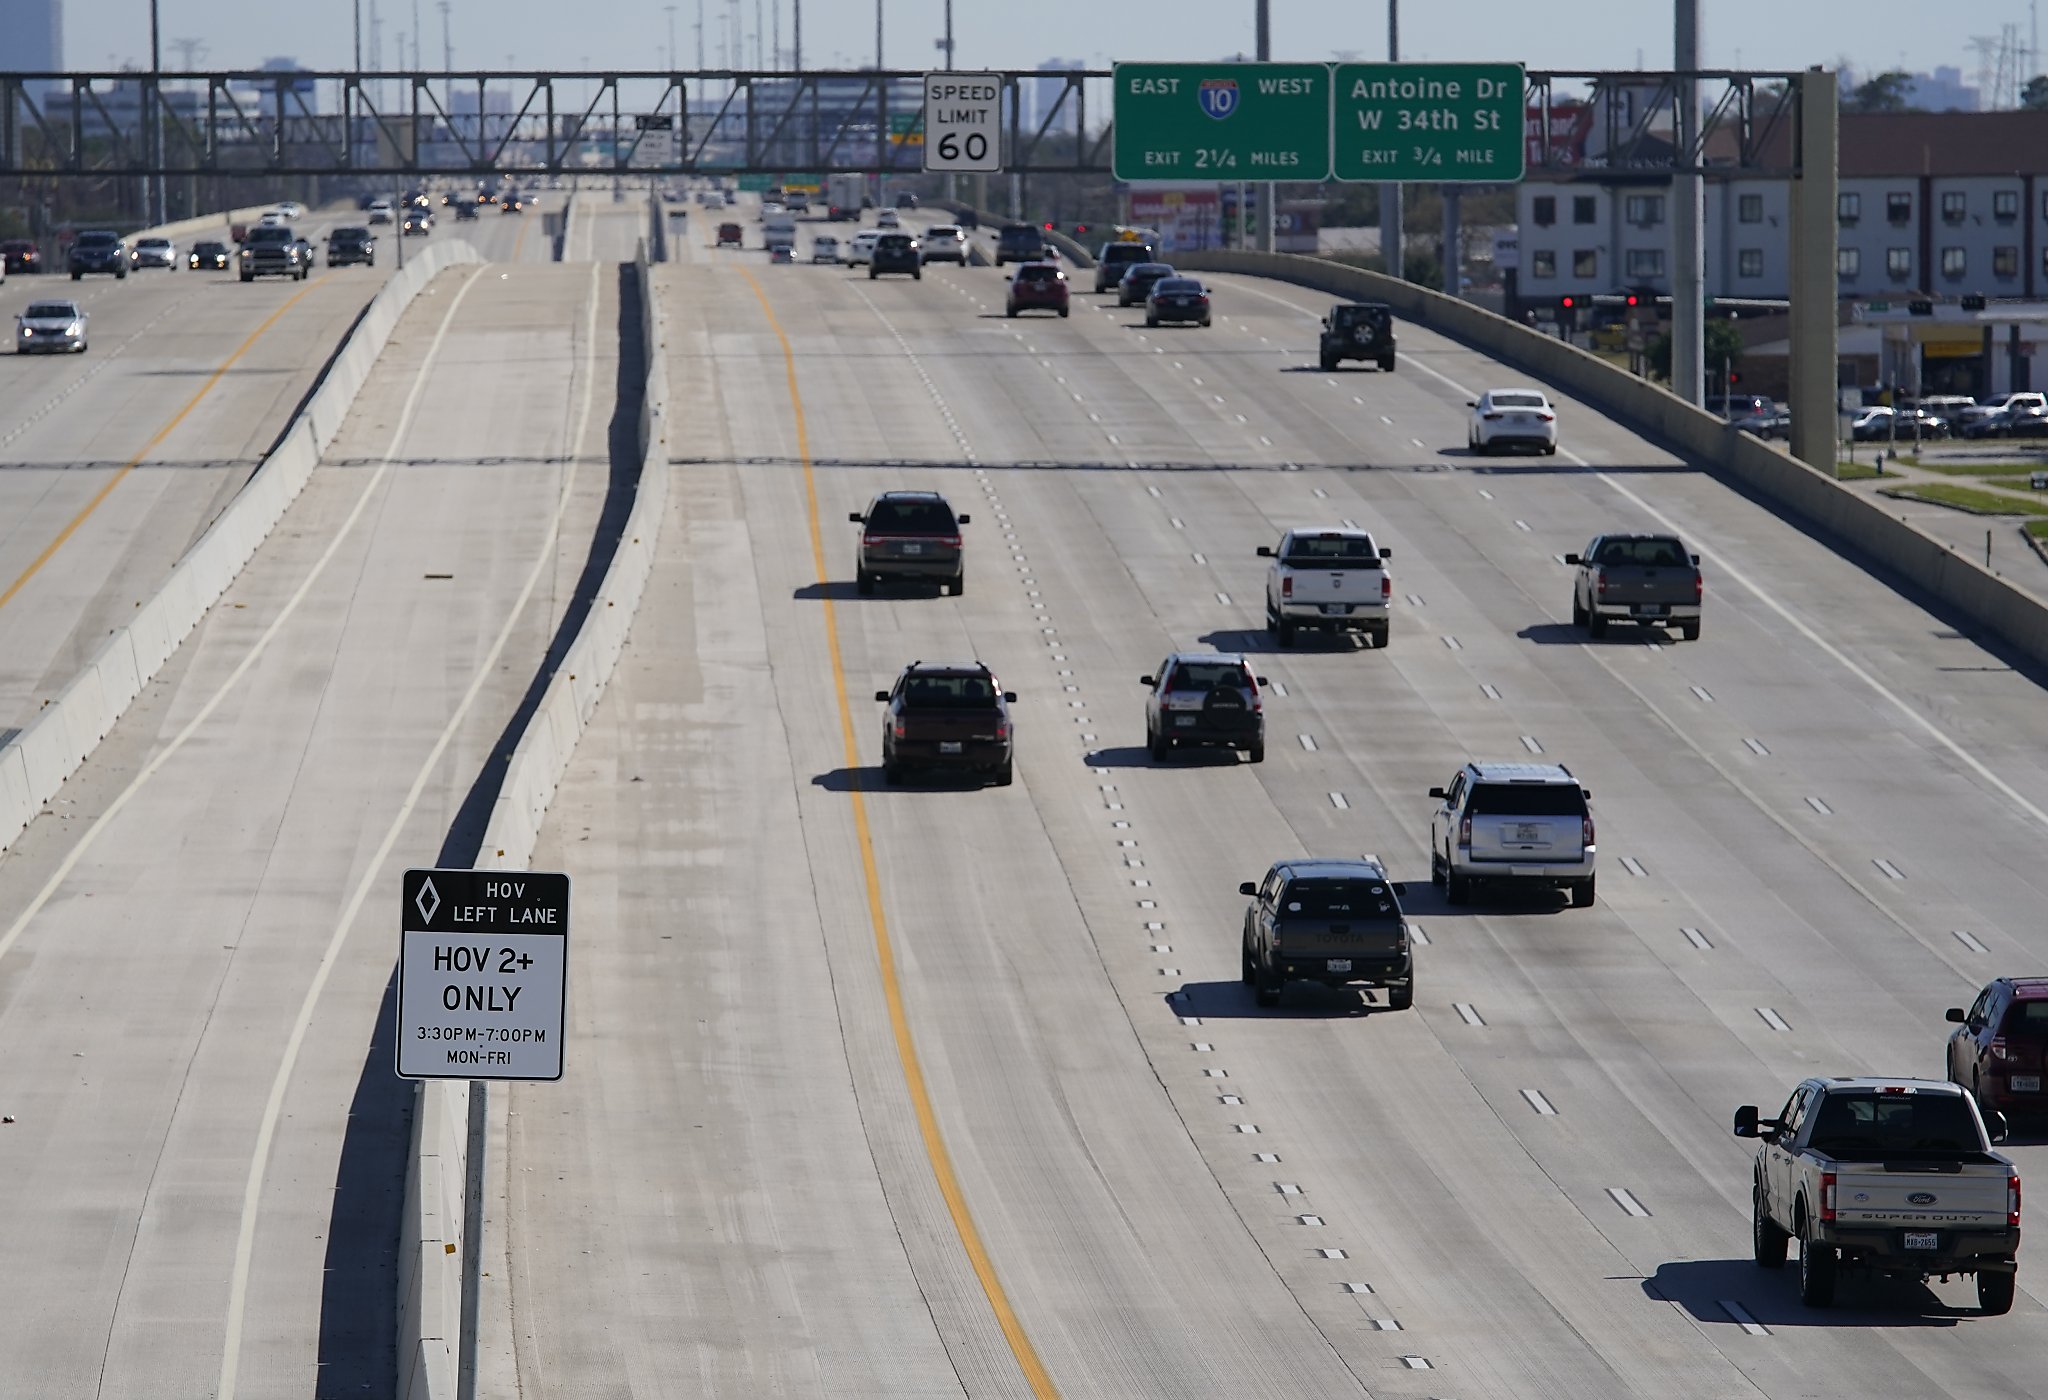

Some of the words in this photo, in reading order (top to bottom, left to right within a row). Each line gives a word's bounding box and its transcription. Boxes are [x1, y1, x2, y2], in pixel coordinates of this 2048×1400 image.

[931, 86, 996, 101] SPEED
[1130, 79, 1180, 94] EAST
[1258, 79, 1313, 94] WEST
[1352, 78, 1461, 99] Antoine
[1477, 78, 1508, 98] Dr
[1208, 89, 1232, 112] 10
[937, 109, 989, 124] LIMIT
[1358, 111, 1382, 130] W
[1397, 109, 1458, 131] 34th
[1474, 110, 1501, 130] St
[938, 133, 987, 161] 60
[1145, 152, 1181, 165] EXIT
[1251, 152, 1299, 165] MILES
[1362, 150, 1398, 164] EXIT
[1456, 150, 1494, 164] MILE
[486, 882, 526, 898] HOV
[453, 906, 497, 923] LEFT
[510, 908, 557, 924] LANE
[1316, 933, 1364, 943] TOYOTA
[434, 946, 491, 972] HOV
[498, 948, 534, 974] 2+
[442, 985, 522, 1012] ONLY
[417, 1026, 546, 1043] 3:30PM-7:00PM
[447, 1050, 511, 1065] MON-FRI
